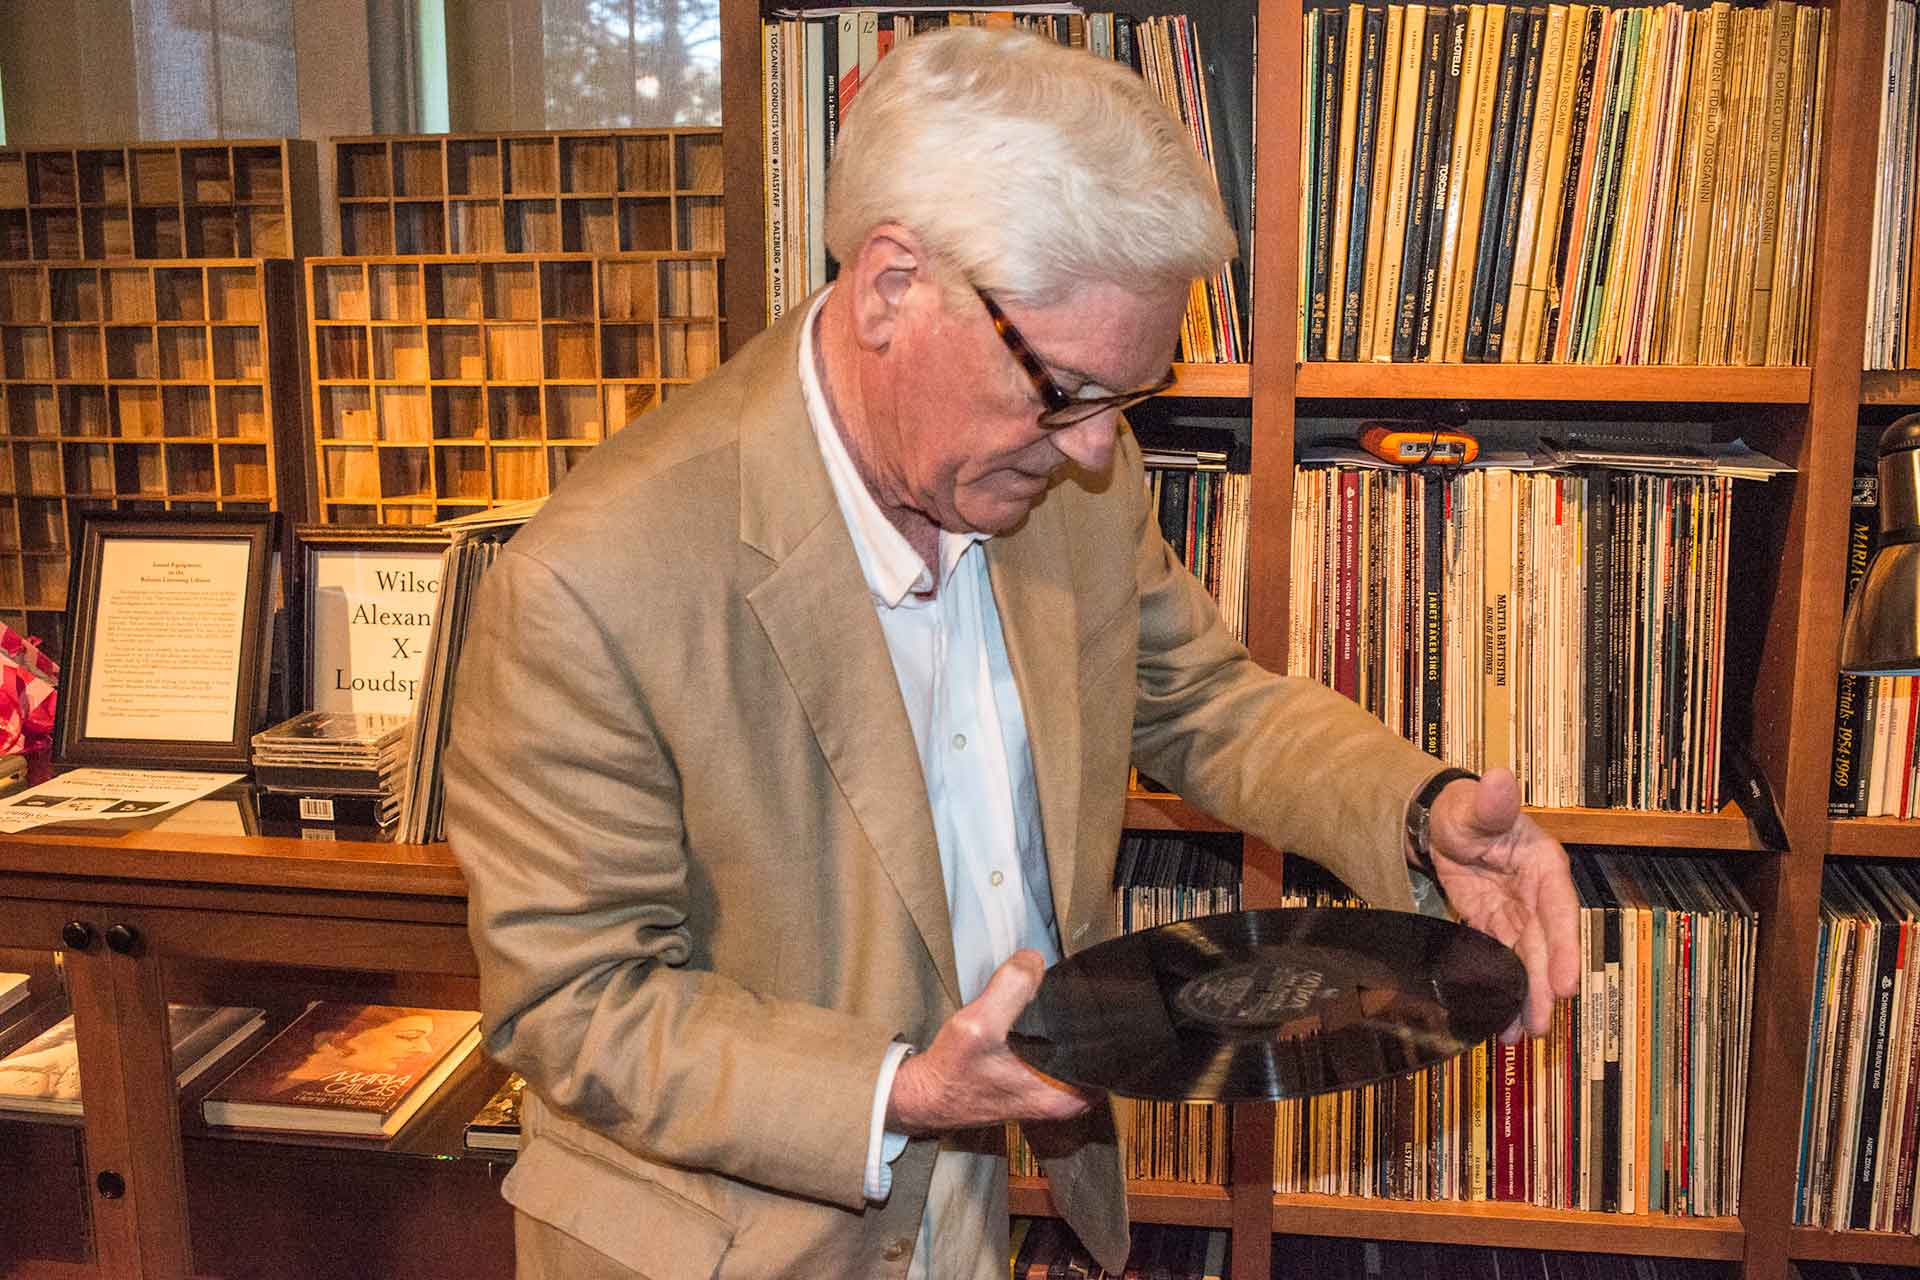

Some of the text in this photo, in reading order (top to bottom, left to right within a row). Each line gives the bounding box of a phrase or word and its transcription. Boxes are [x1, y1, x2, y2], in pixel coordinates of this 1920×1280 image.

[843, 20, 854, 33] 6
[861, 20, 876, 34] 12
[770, 32, 779, 80] TOSCANINI
[1555, 20, 1580, 137] WAGNER AND TOSCANINI
[1774, 72, 1786, 114] ROMEO
[771, 81, 779, 128] CONDUCTS
[1578, 77, 1591, 120] TOSCANINI
[1706, 89, 1720, 134] FIDELIO
[1424, 98, 1433, 134] TOSCANINI
[1770, 119, 1781, 143] UND
[771, 130, 780, 155] VERDI
[1574, 122, 1584, 157] OMNIBUS
[1700, 143, 1716, 204] TOSCANINI
[1767, 149, 1778, 177] JULIA
[772, 167, 781, 208] FALSTAFF
[1436, 164, 1449, 210] TOSCANINI
[1566, 166, 1579, 209] TOSCANINI
[1414, 199, 1423, 225] OTELLO
[1762, 185, 1775, 245] TOSCANINI
[773, 221, 782, 264] SALZBURG
[774, 276, 782, 298] AIDA
[1426, 269, 1435, 284] RCA
[1423, 283, 1433, 313] VICTROLA
[1347, 524, 1353, 534] OF
[1595, 543, 1604, 575] VERDI
[1850, 523, 1870, 575] MARIA
[351, 602, 432, 627] Alexan
[1428, 591, 1438, 620] JANET
[391, 637, 422, 659] X-
[1428, 622, 1438, 653] BAKER
[1486, 606, 1494, 676] KING OF BARITONES
[1497, 594, 1507, 687] MATTIA BATTISTINI
[1428, 655, 1438, 681] SINGS
[1428, 722, 1438, 736] SLS
[1876, 991, 1890, 1037] SCHWARZKOPF
[1874, 1050, 1883, 1069] EARLY
[1876, 1038, 1885, 1051] THE
[320, 1071, 413, 1087] MARIA
[1873, 1069, 1881, 1089] YEARS
[1865, 1136, 1874, 1156] ANGEL
